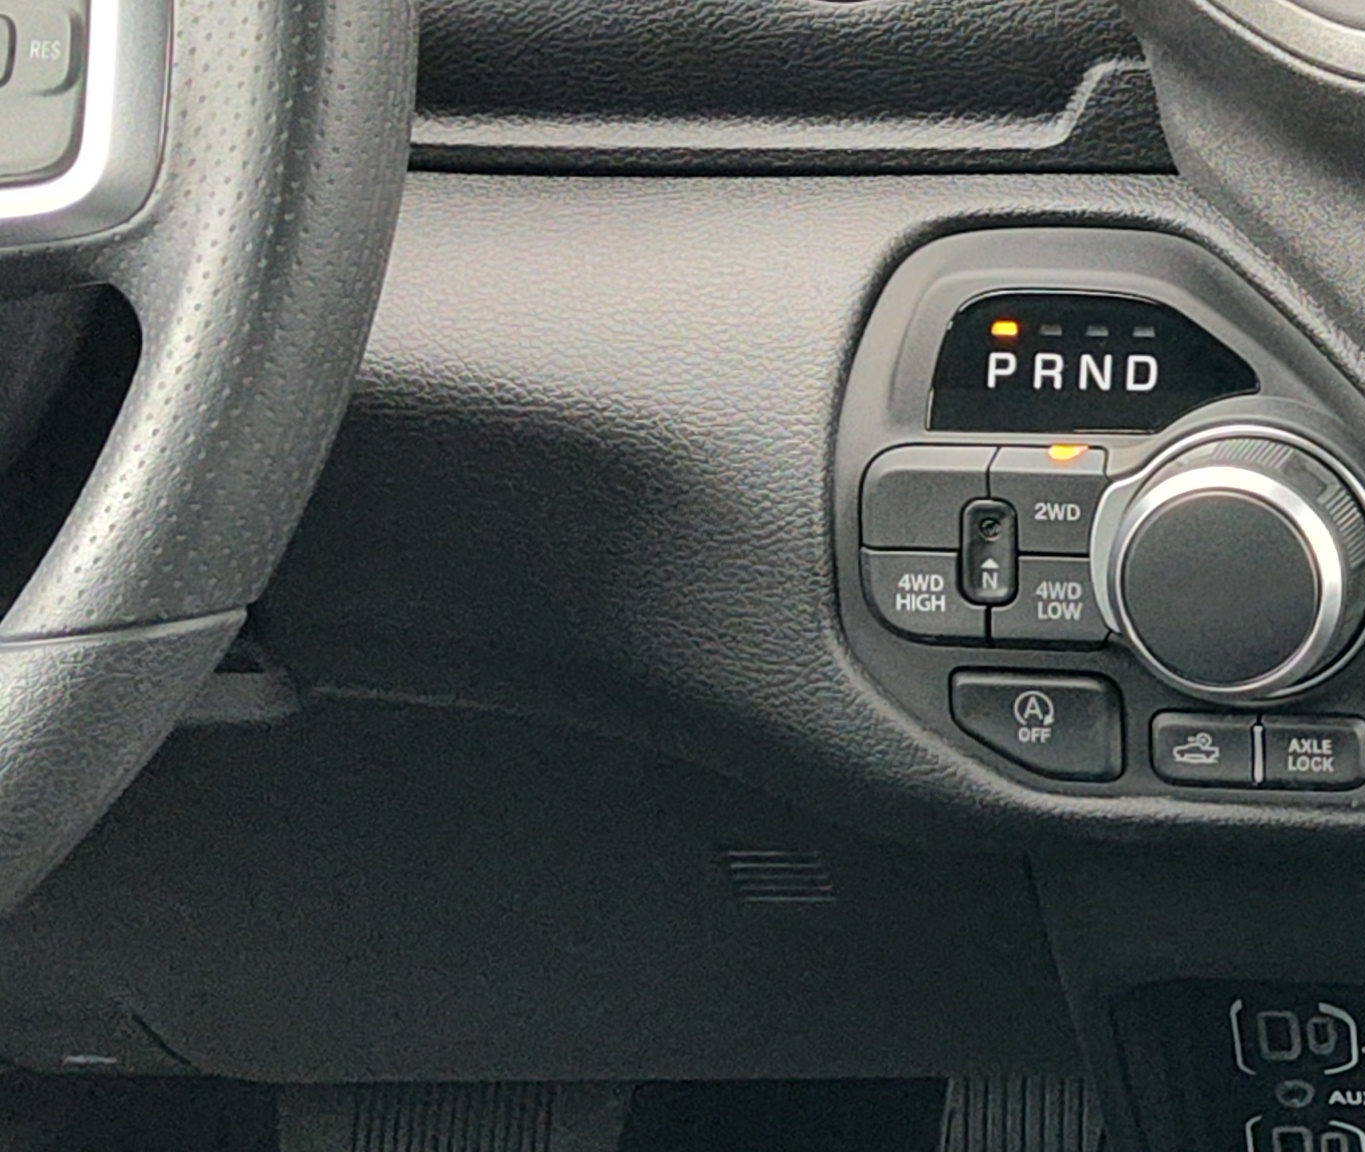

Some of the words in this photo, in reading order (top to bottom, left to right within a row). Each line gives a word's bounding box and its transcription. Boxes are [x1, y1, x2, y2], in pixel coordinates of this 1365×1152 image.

[29, 40, 62, 59] RES
[1034, 503, 1080, 521] 2WD
[898, 574, 944, 591] 4WD
[982, 572, 998, 589] N
[1036, 582, 1082, 600] 4WD
[895, 594, 946, 612] HIGH
[1037, 602, 1082, 620] LOW
[1018, 727, 1051, 742] OFF
[1288, 738, 1332, 755] AXLE
[1288, 756, 1334, 772] LOCK
